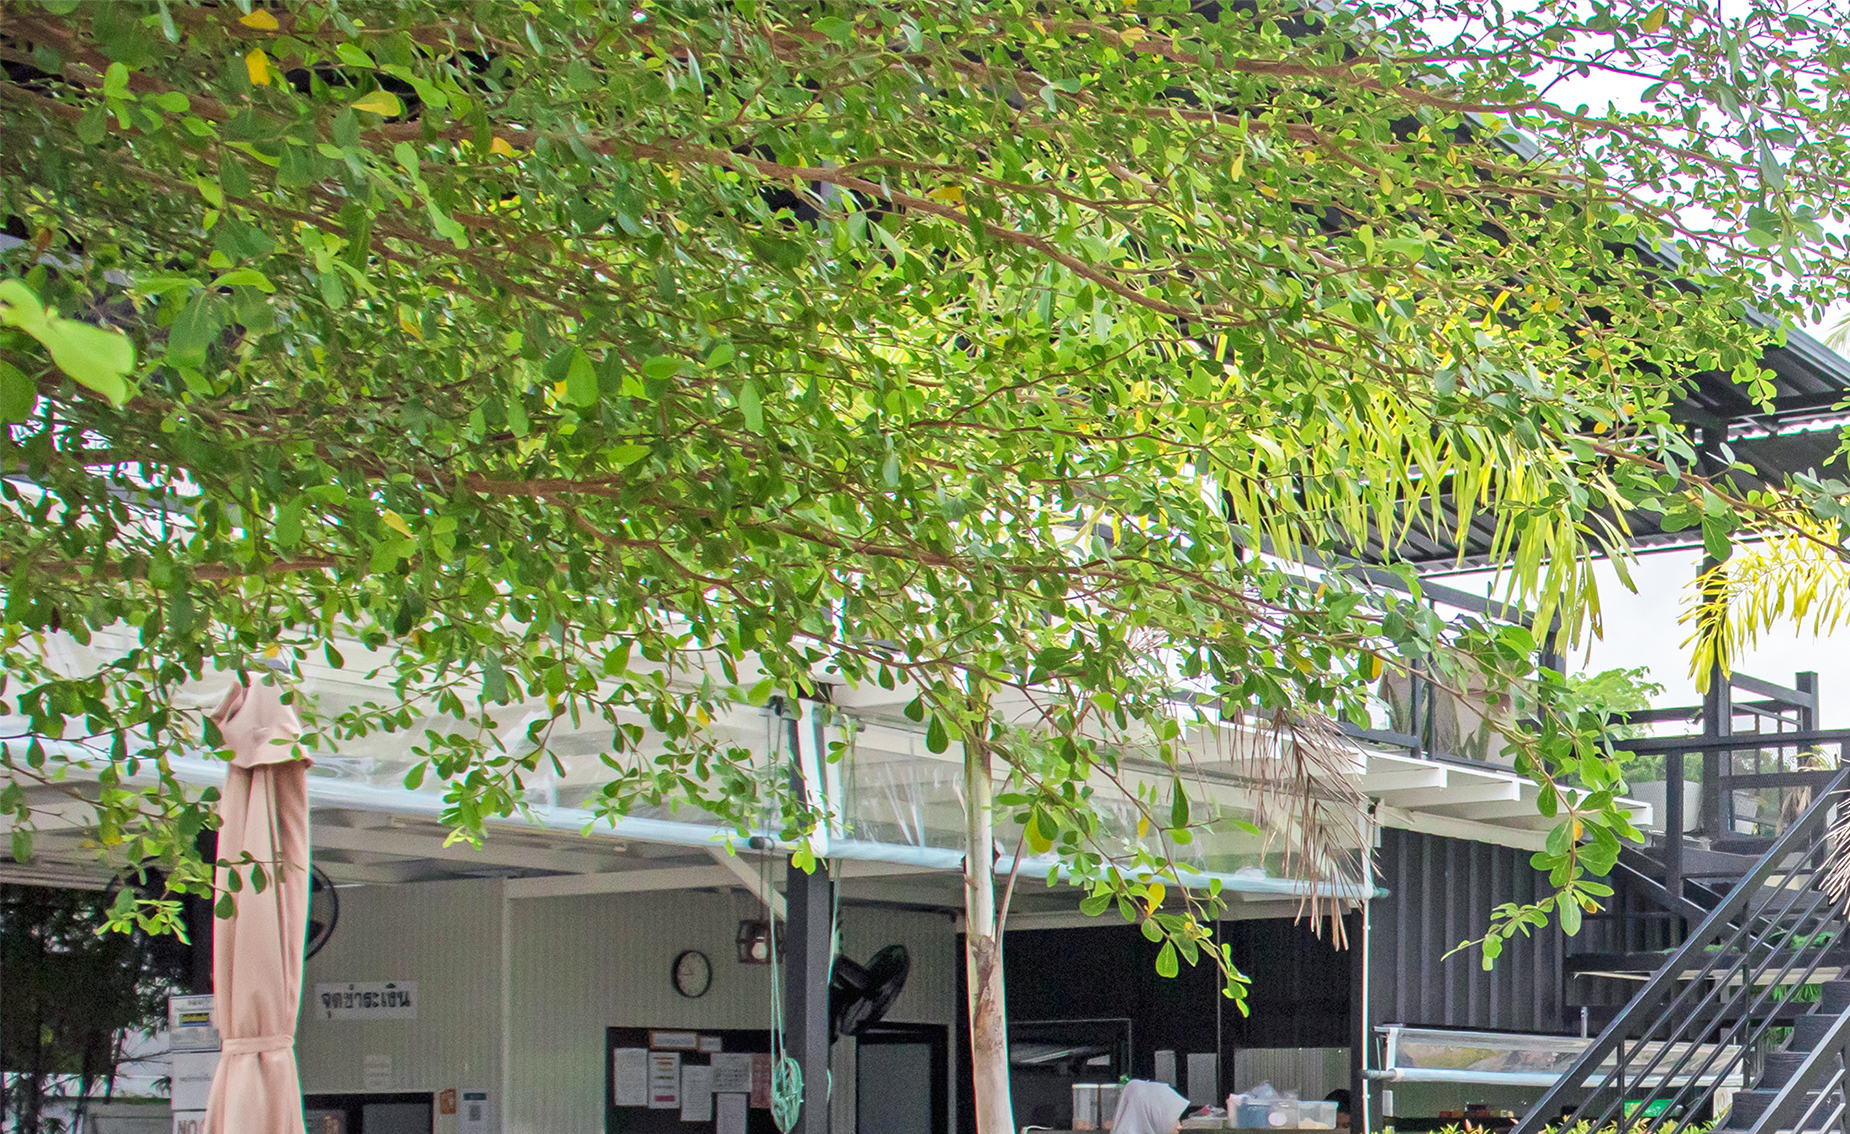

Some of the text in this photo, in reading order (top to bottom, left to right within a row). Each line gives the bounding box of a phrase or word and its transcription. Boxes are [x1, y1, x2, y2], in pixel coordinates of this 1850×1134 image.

[320, 982, 411, 1019] จุดชำระเงิน
